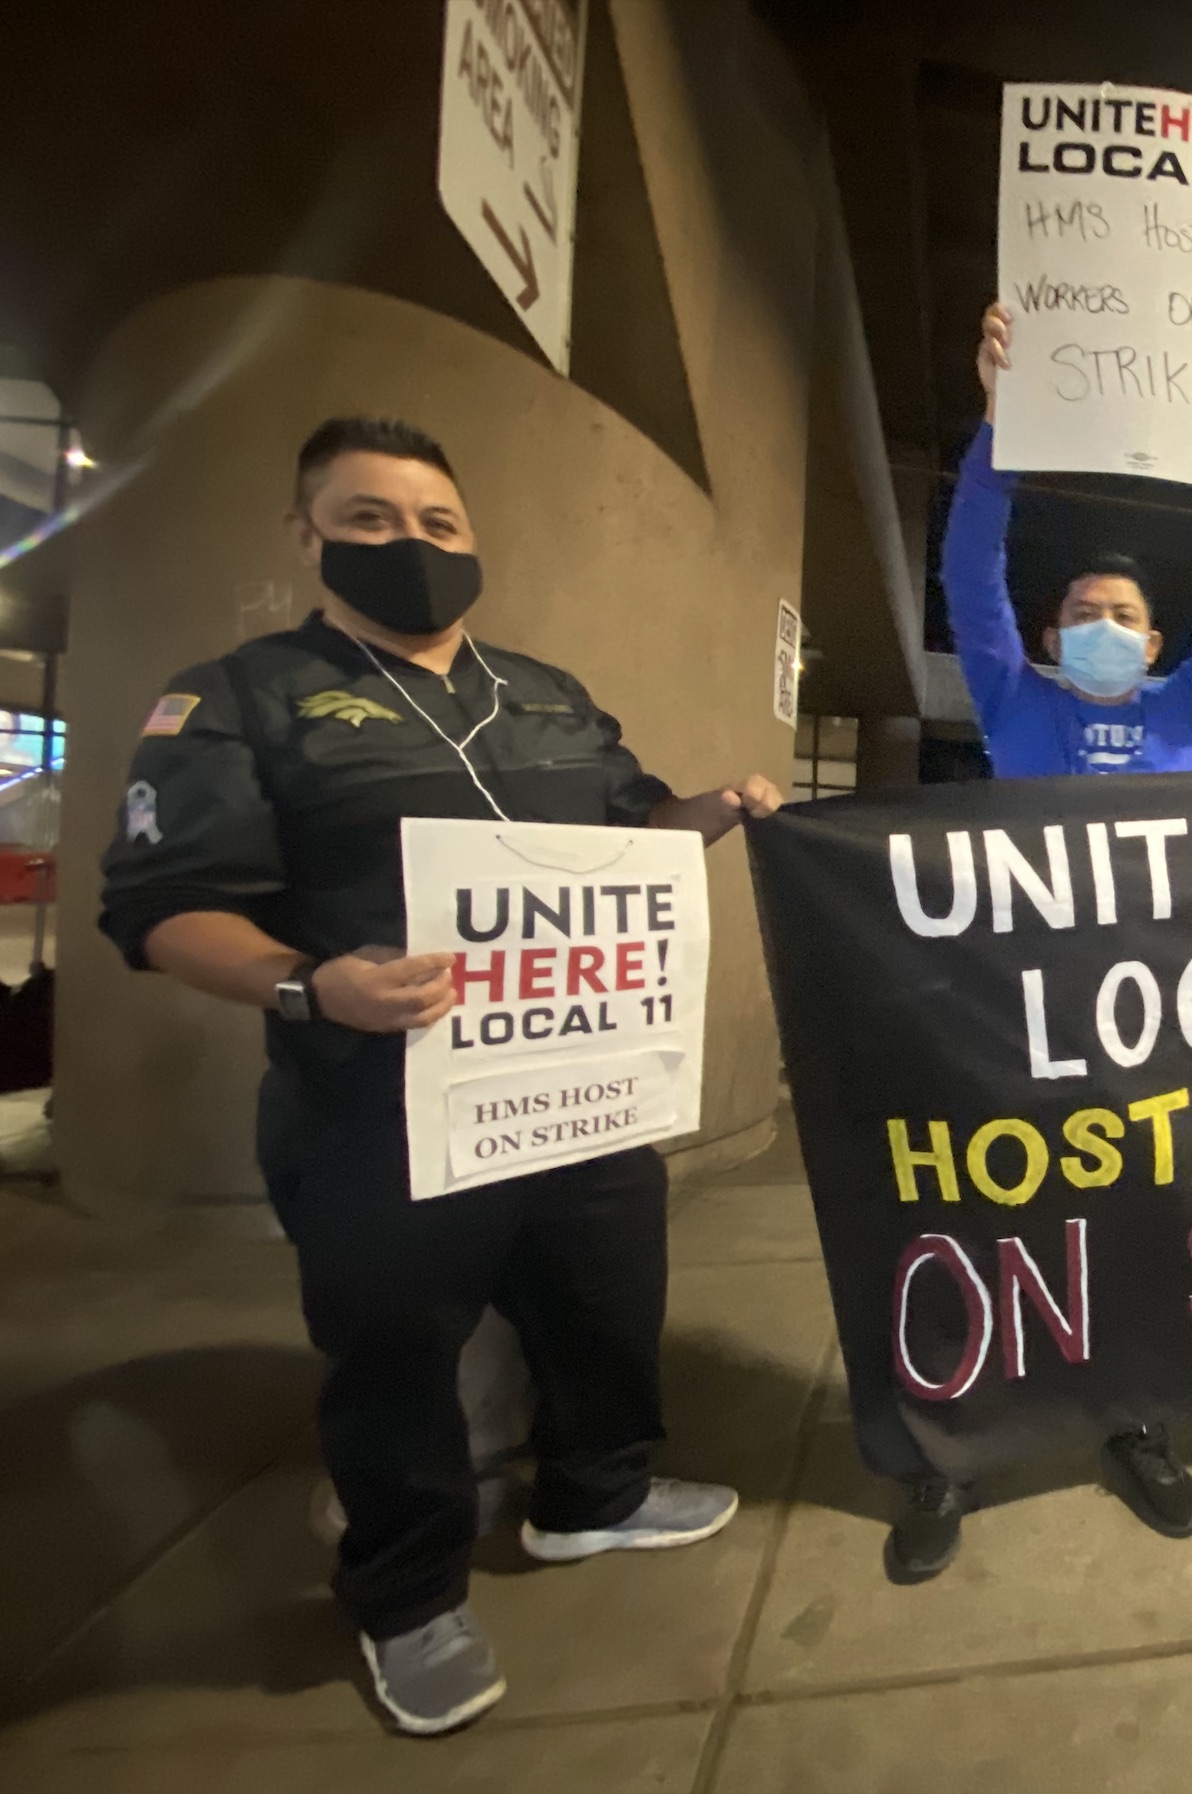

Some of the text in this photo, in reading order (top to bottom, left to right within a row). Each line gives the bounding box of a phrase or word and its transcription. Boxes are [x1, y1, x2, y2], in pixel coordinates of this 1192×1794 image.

[457, 18, 515, 171] AREA
[1026, 201, 1110, 241] HMS
[1014, 274, 1129, 314] WORKERS
[456, 884, 675, 943] UNITE
[450, 939, 669, 1005] HERE!
[451, 994, 672, 1050] LOCAL 11
[474, 1077, 640, 1124] HMS HOST
[474, 1106, 640, 1160] ON STRIKE
[887, 1087, 1190, 1206] HOST
[892, 1217, 1090, 1400] ON
